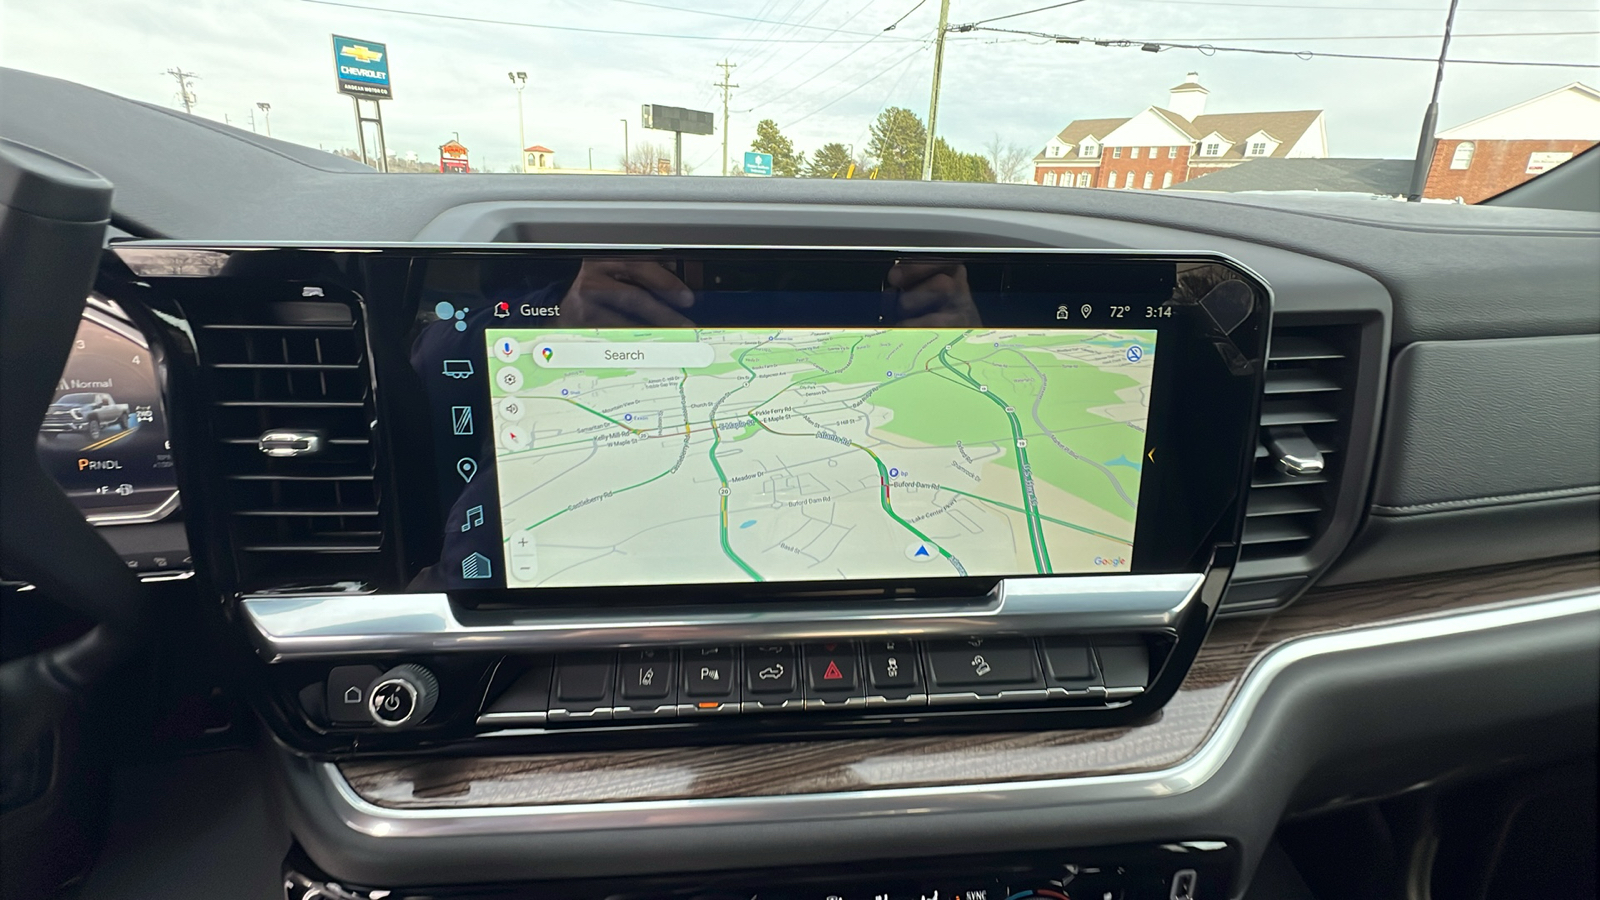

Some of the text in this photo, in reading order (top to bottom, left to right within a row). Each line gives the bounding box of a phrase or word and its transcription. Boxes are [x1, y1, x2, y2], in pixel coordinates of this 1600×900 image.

[340, 65, 386, 79] CHEVROLET
[520, 303, 560, 316] Guest
[1109, 305, 1172, 318] 72° 3:14
[76, 340, 86, 349] 3
[131, 355, 141, 365] 4
[604, 349, 645, 361] Search
[70, 378, 113, 389] Normal
[770, 407, 784, 415] Ferry
[816, 430, 851, 446] Atlanta Rd
[951, 460, 975, 477] Shamrock
[732, 473, 756, 483] Meadow
[101, 486, 109, 494] F
[568, 494, 603, 511] Castleberry
[788, 500, 807, 508] Buford
[911, 516, 925, 524] Lake
[925, 508, 944, 518] Center
[1094, 557, 1125, 567] Google
[966, 890, 987, 900] SYNC
